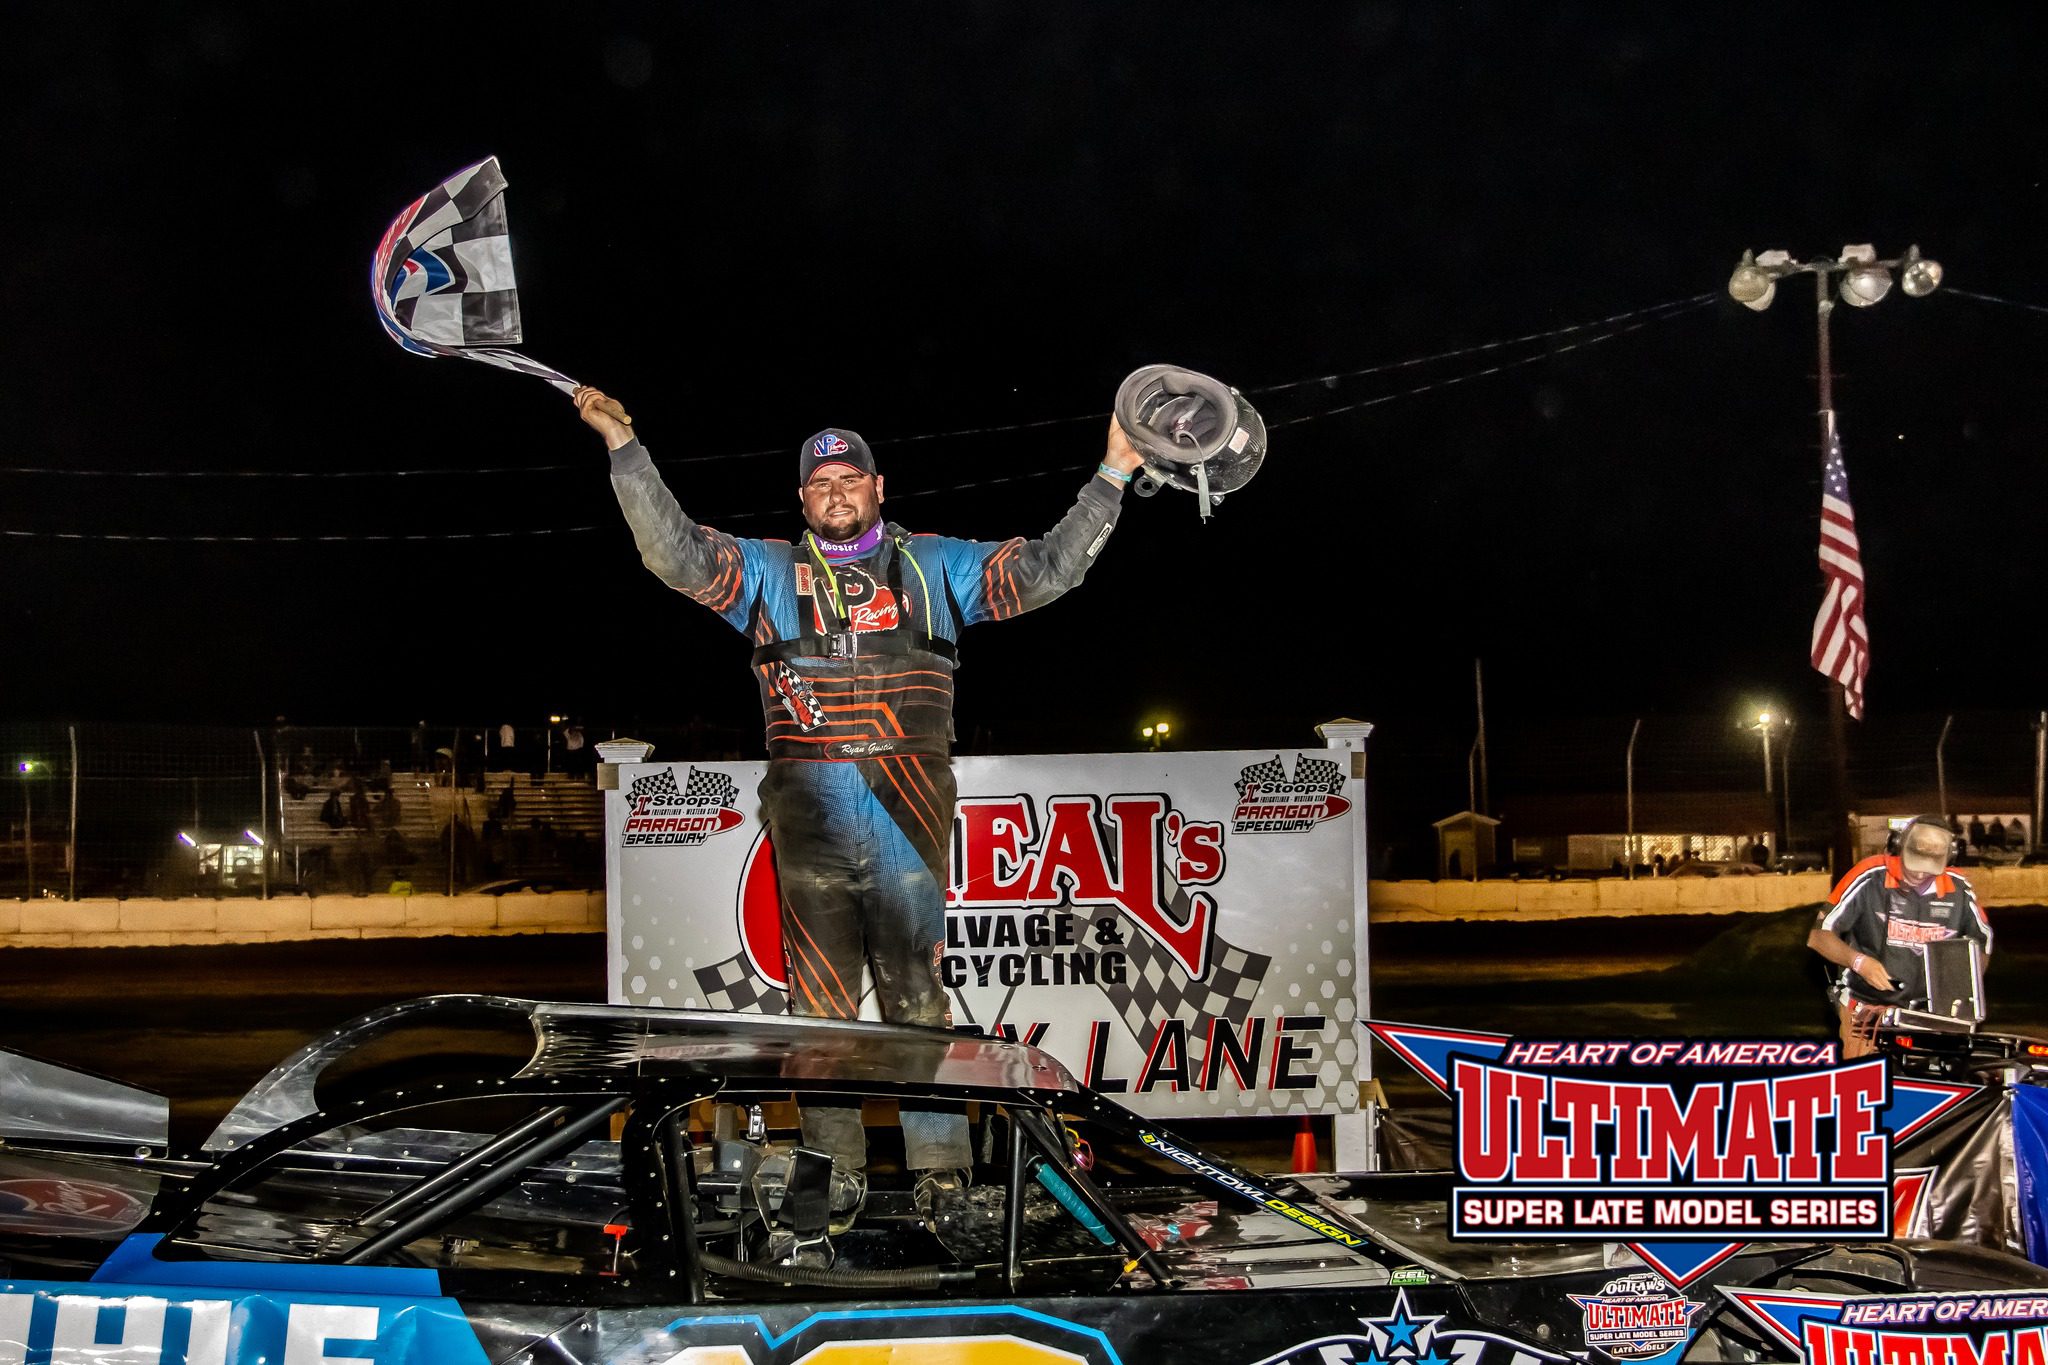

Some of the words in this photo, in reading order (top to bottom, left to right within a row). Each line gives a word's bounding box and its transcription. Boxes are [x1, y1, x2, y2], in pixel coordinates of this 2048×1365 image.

[815, 434, 837, 456] VP
[820, 540, 859, 551] Hoosier
[853, 602, 898, 633] Racing
[841, 744, 865, 755] Ryan
[868, 742, 893, 754] Gustin
[1260, 783, 1328, 794] Stoops
[653, 795, 721, 807] Stoops
[1235, 805, 1325, 819] PARAGON
[626, 818, 718, 832] PARAGON
[1235, 820, 1314, 832] SPEEDWAY
[626, 833, 706, 844] SPEEDWAY
[946, 796, 1225, 983] EAL's
[946, 914, 1074, 948] LVAGE
[1094, 915, 1124, 945] &
[942, 952, 1127, 987] CYCLING
[1084, 1016, 1326, 1094] LANE
[1393, 1271, 1427, 1279] GEL
[1587, 1299, 1686, 1329] ULTIMATE
[1840, 1303, 1934, 1324] HEART
[1935, 1301, 1973, 1322] OF
[1590, 1332, 1613, 1341] SUPER
[1659, 1329, 1685, 1337] SERIES
